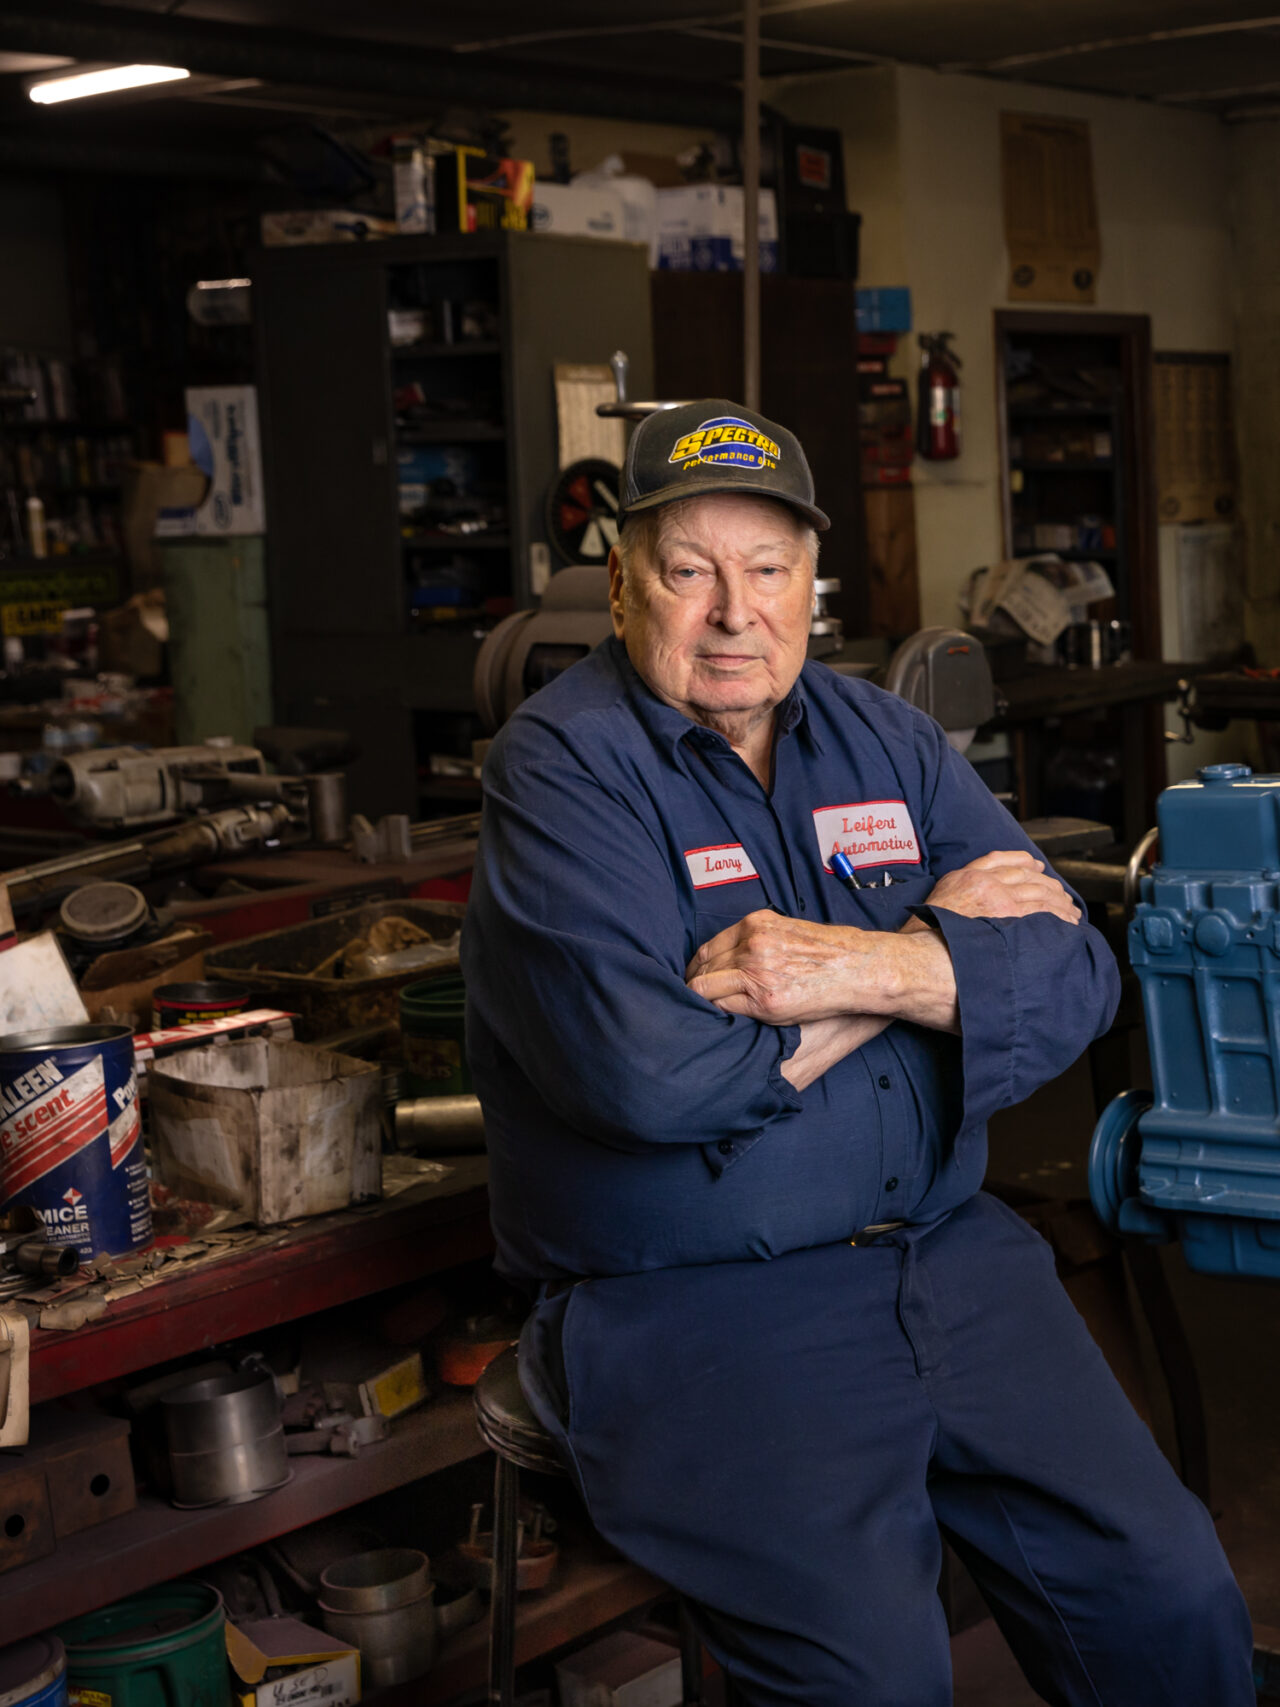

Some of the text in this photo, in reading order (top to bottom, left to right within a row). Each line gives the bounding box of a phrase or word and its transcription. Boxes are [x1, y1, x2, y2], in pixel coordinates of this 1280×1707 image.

[842, 815, 897, 836] Leifert
[831, 835, 914, 857] Automotive
[704, 856, 742, 872] Larry
[14, 1088, 75, 1139] scent
[37, 1204, 89, 1225] MICE
[46, 1222, 90, 1237] EANER
